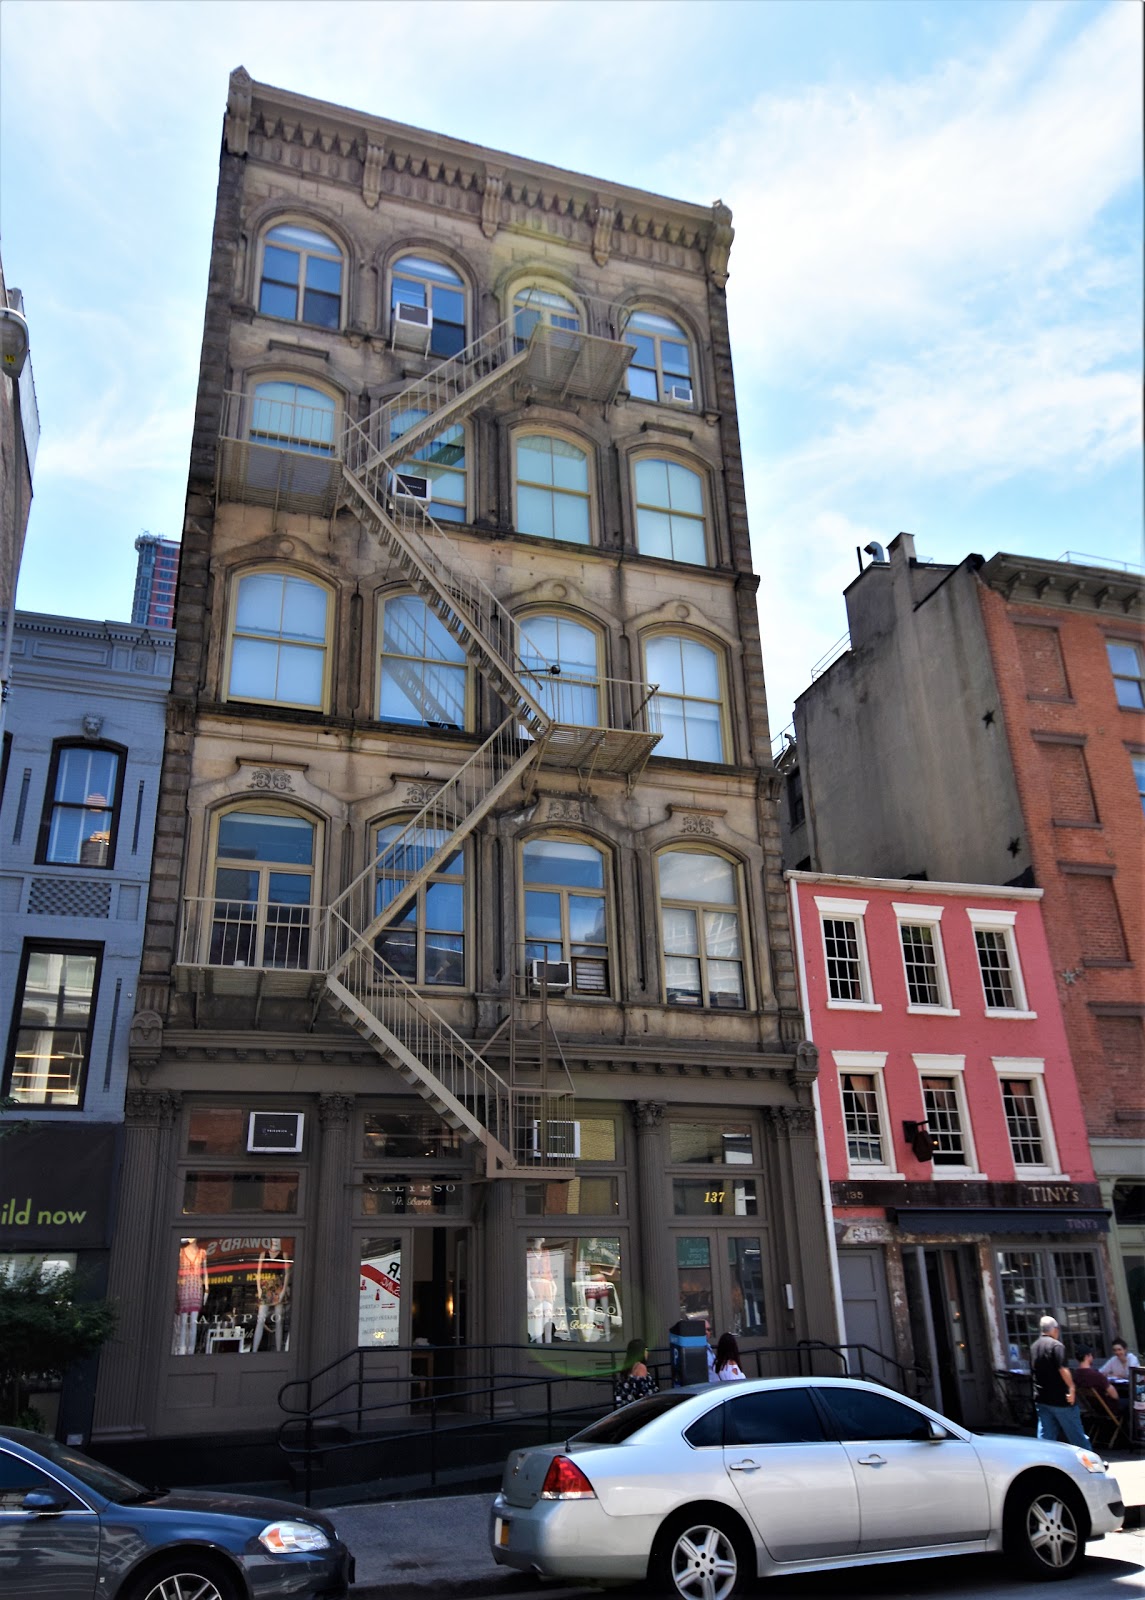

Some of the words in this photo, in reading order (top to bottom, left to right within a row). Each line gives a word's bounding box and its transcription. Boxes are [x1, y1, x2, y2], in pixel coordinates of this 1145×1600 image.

[704, 1191, 725, 1203] 137
[1, 1198, 32, 1225] ild
[37, 1210, 87, 1225] now
[182, 1314, 281, 1325] ALYPO
